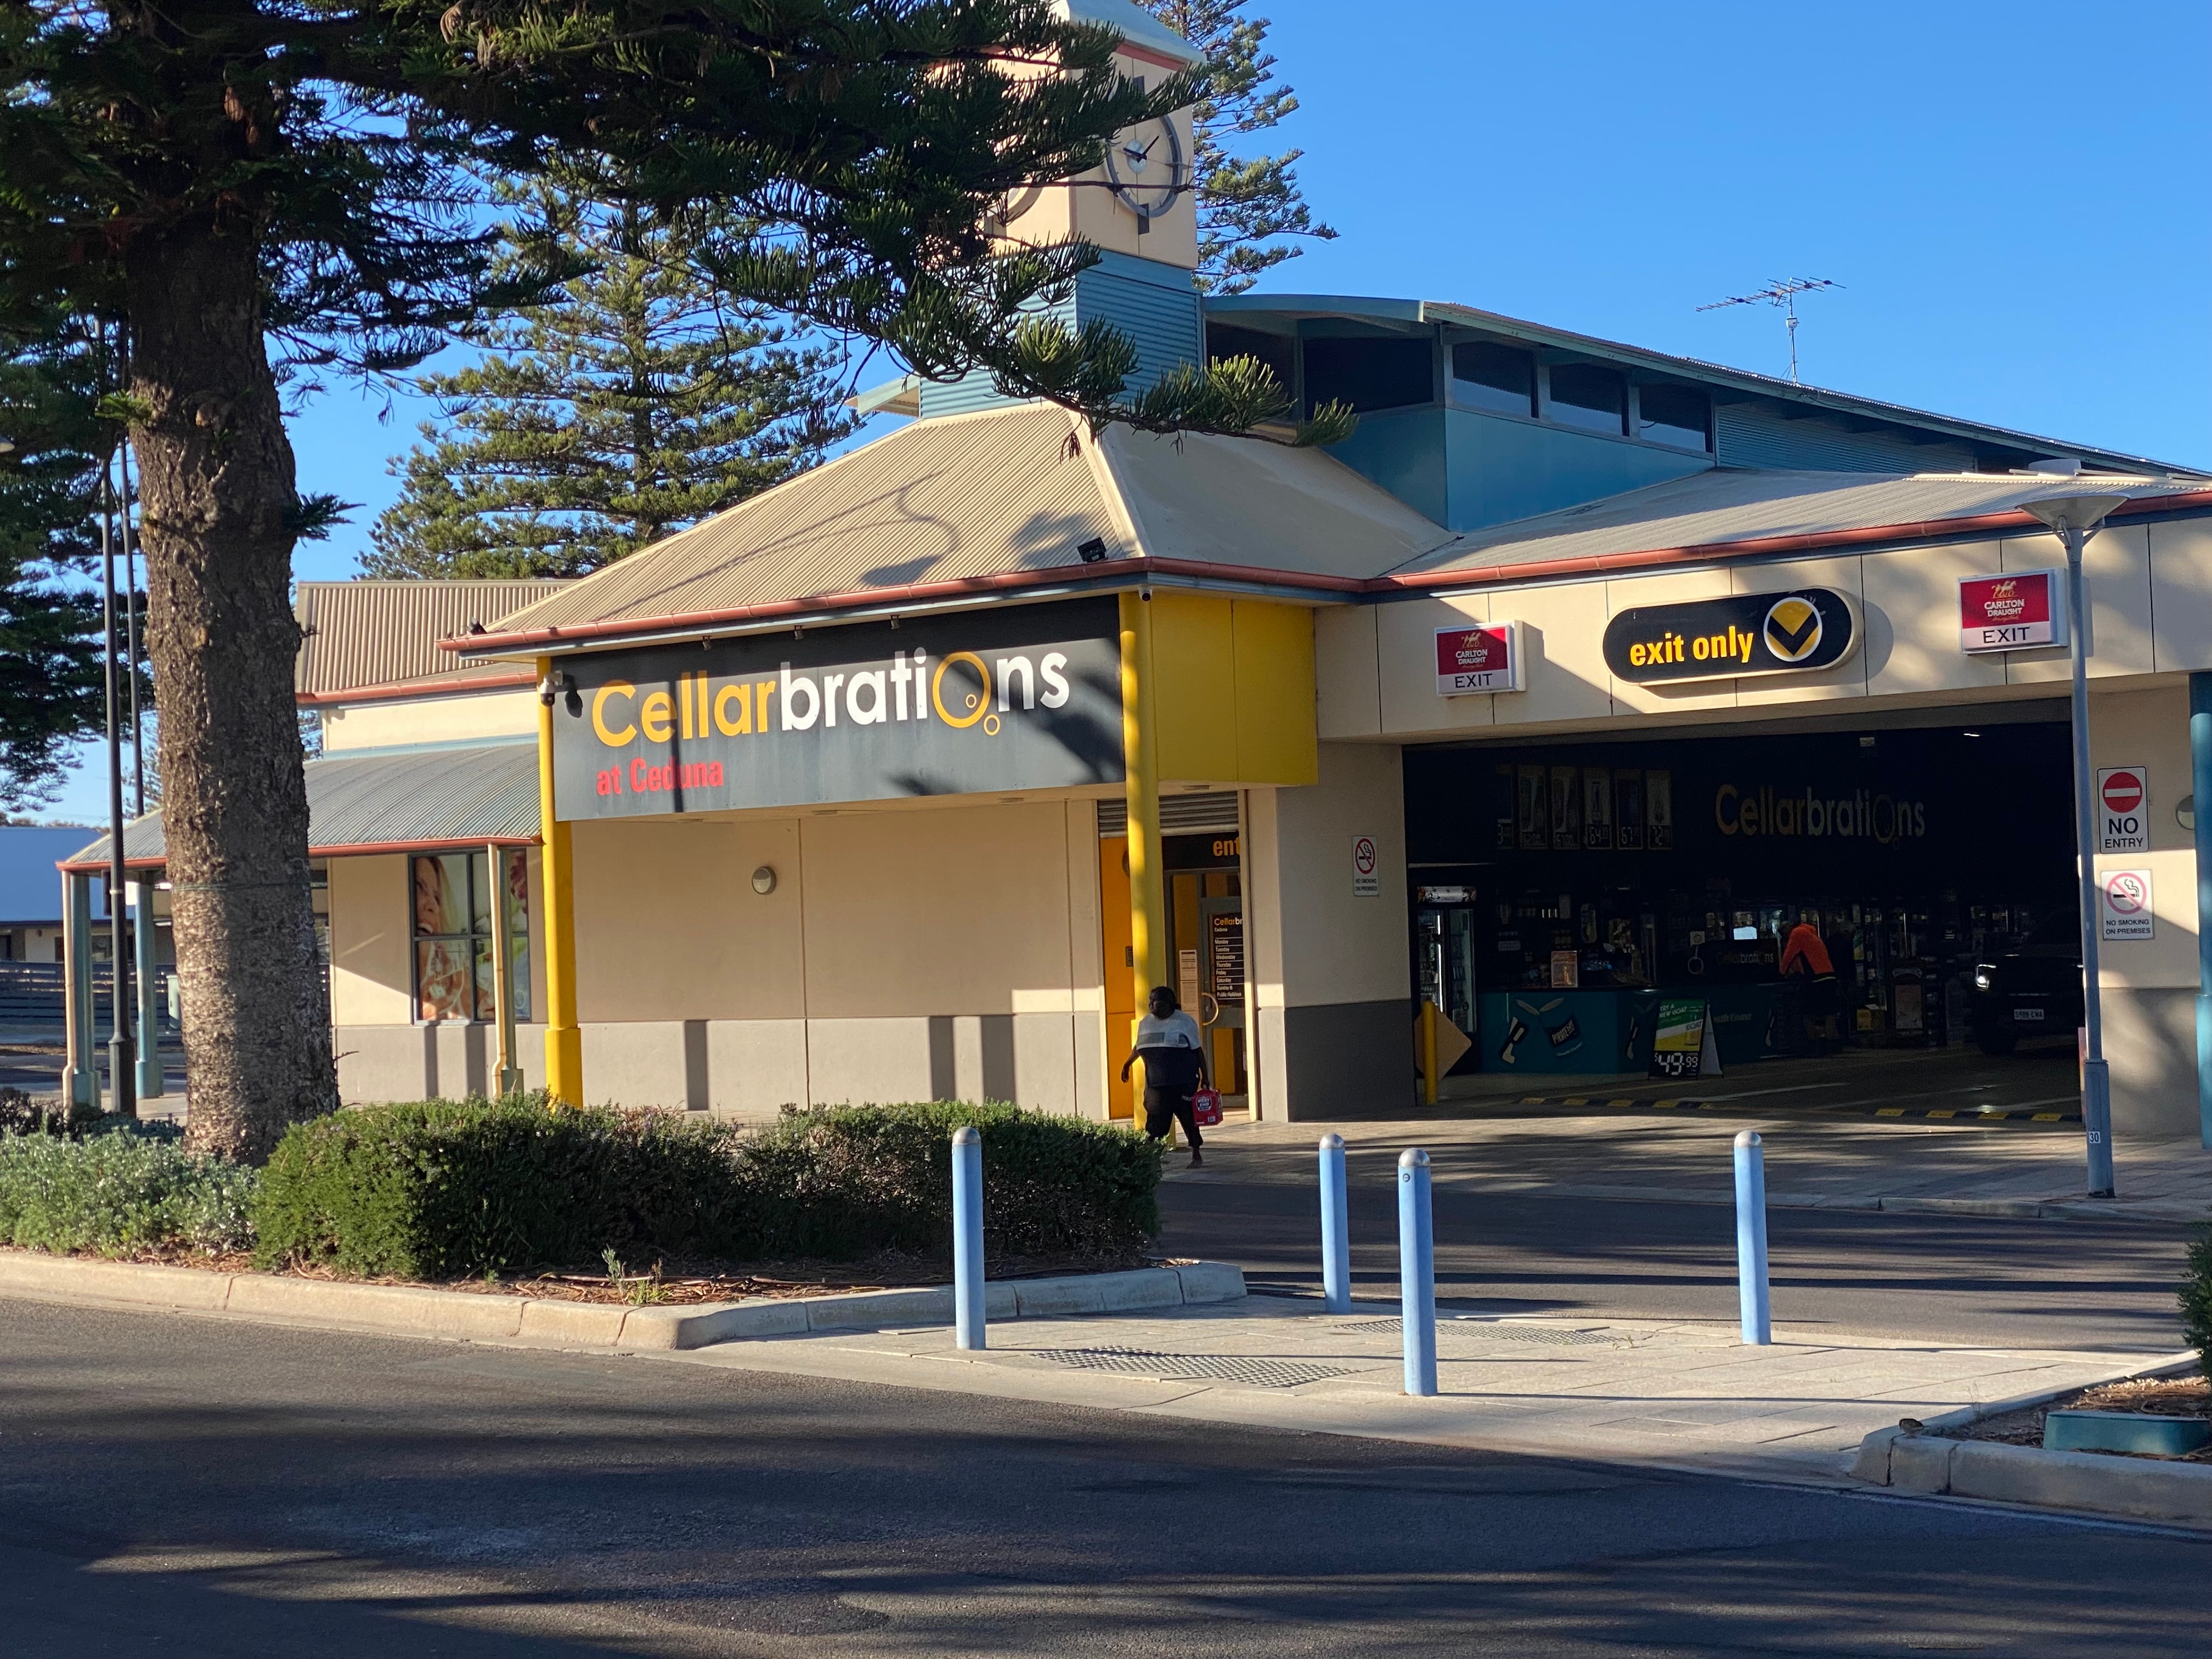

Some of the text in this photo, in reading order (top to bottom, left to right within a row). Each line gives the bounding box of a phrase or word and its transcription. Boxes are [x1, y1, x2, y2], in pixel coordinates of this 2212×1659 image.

[1984, 599, 2025, 610] CARLTON
[1987, 607, 2022, 617] DRAUGHT
[1983, 627, 2030, 644] EXIT
[1630, 625, 1754, 667] exit only
[1455, 649, 1488, 658] CARLTON
[1458, 657, 1486, 665] DRAUGHT
[1455, 673, 1492, 688] EXIT
[592, 646, 1070, 747] Cellarbrations
[596, 755, 724, 795] at Ceduna
[2108, 817, 2138, 834] NO
[2105, 837, 2143, 848] ENTRY
[2090, 1133, 2099, 1142] 30
